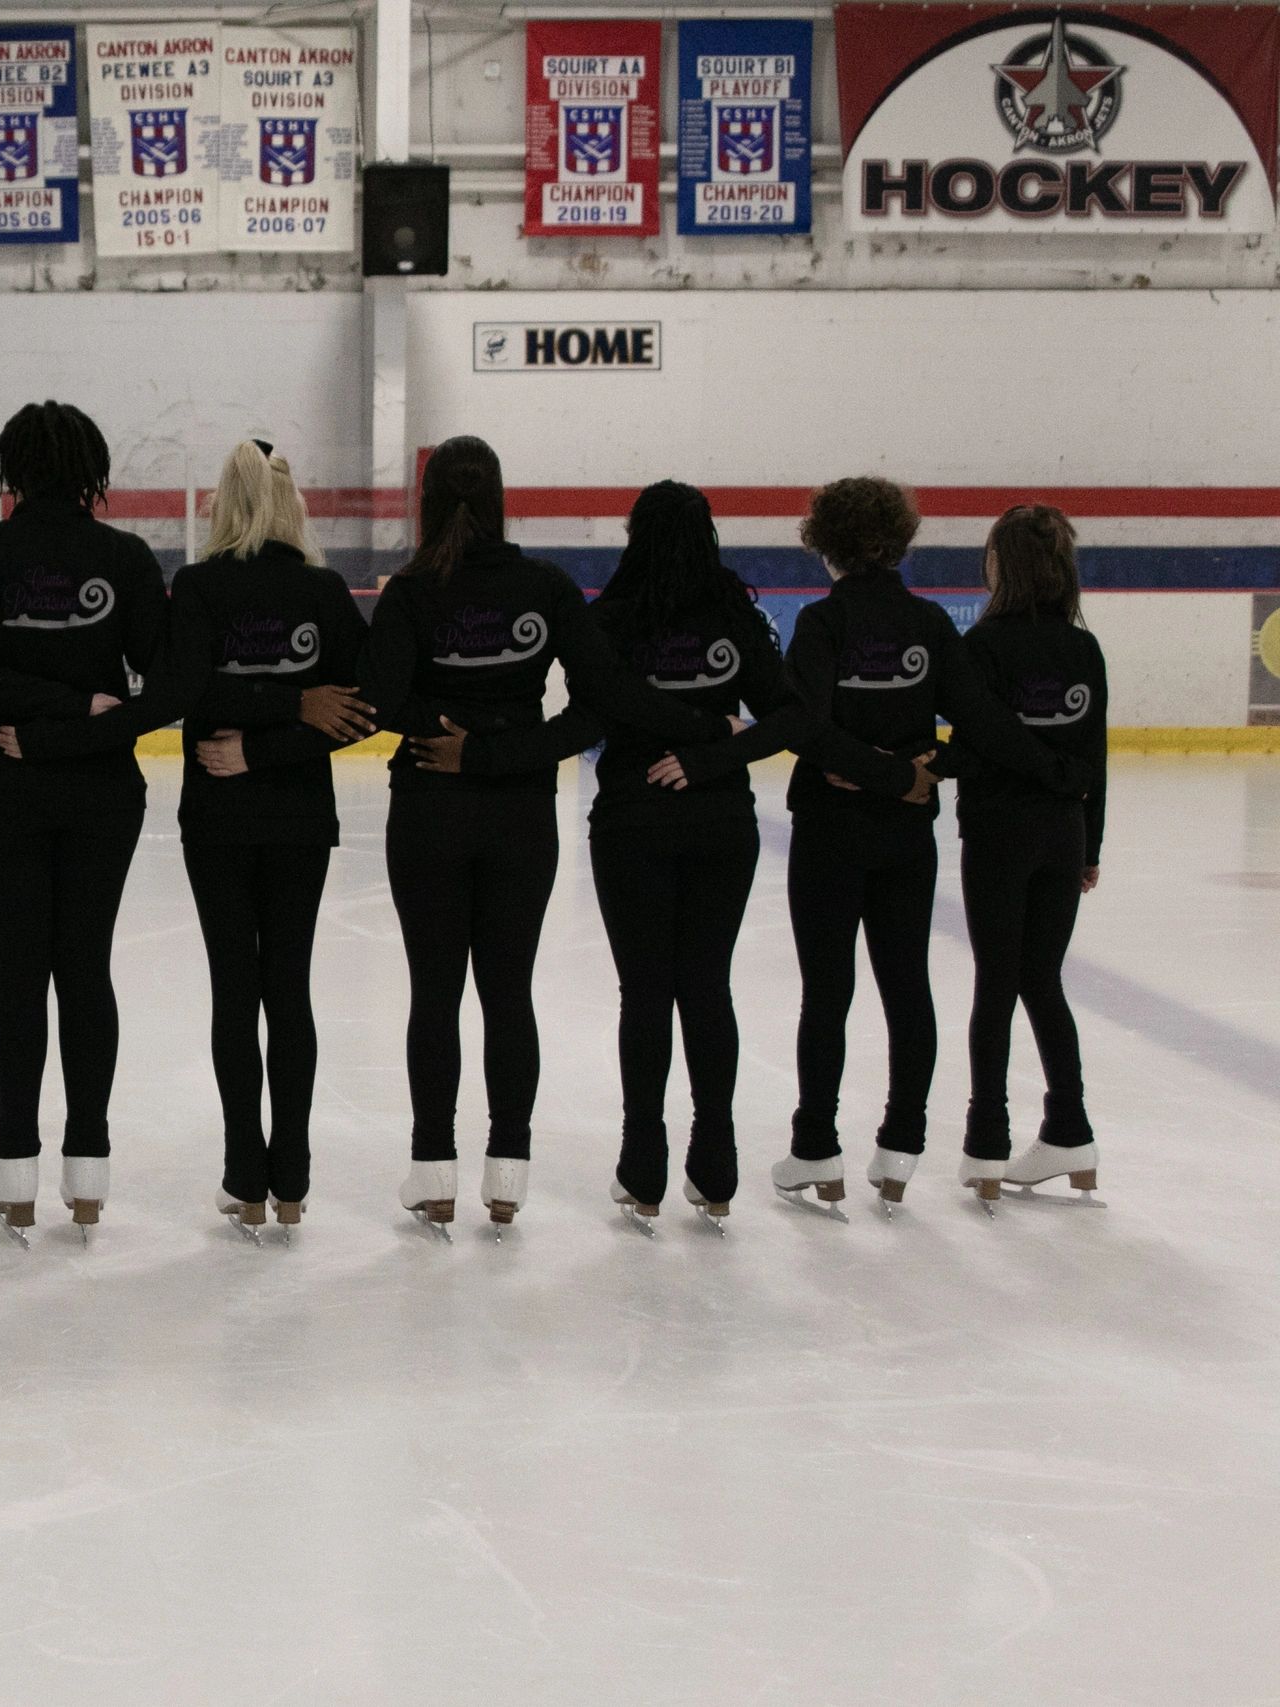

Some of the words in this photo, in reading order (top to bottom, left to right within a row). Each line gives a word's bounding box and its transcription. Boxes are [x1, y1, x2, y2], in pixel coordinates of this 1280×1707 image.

[16, 43, 66, 59] AKRON
[97, 41, 157, 58] CANTON
[163, 38, 214, 54] AKRON
[225, 48, 291, 64] CANTON
[298, 48, 354, 64] AKRON
[40, 65, 63, 81] B2
[102, 61, 175, 79] PEEWEE
[188, 60, 210, 75] A3
[547, 58, 609, 75] SQUIRT
[618, 58, 641, 74] AA
[701, 58, 768, 75] SQUIRT
[775, 58, 792, 74] B1
[243, 70, 304, 86] SQUIRT
[313, 71, 334, 86] A3
[121, 83, 194, 100] DIVISION
[557, 80, 630, 96] DIVISION
[710, 80, 782, 96] PLAYOFF
[252, 92, 325, 108] DIVISION
[1001, 97, 1039, 142] CANTON
[1048, 129, 1093, 147] AKRON
[550, 185, 635, 202] CHAMPION
[702, 185, 788, 202] CHAMPION
[861, 157, 1248, 219] HOCKEY
[119, 188, 204, 207] CHAMPION
[245, 198, 329, 214] CHAMPION
[525, 328, 653, 365] HOME
